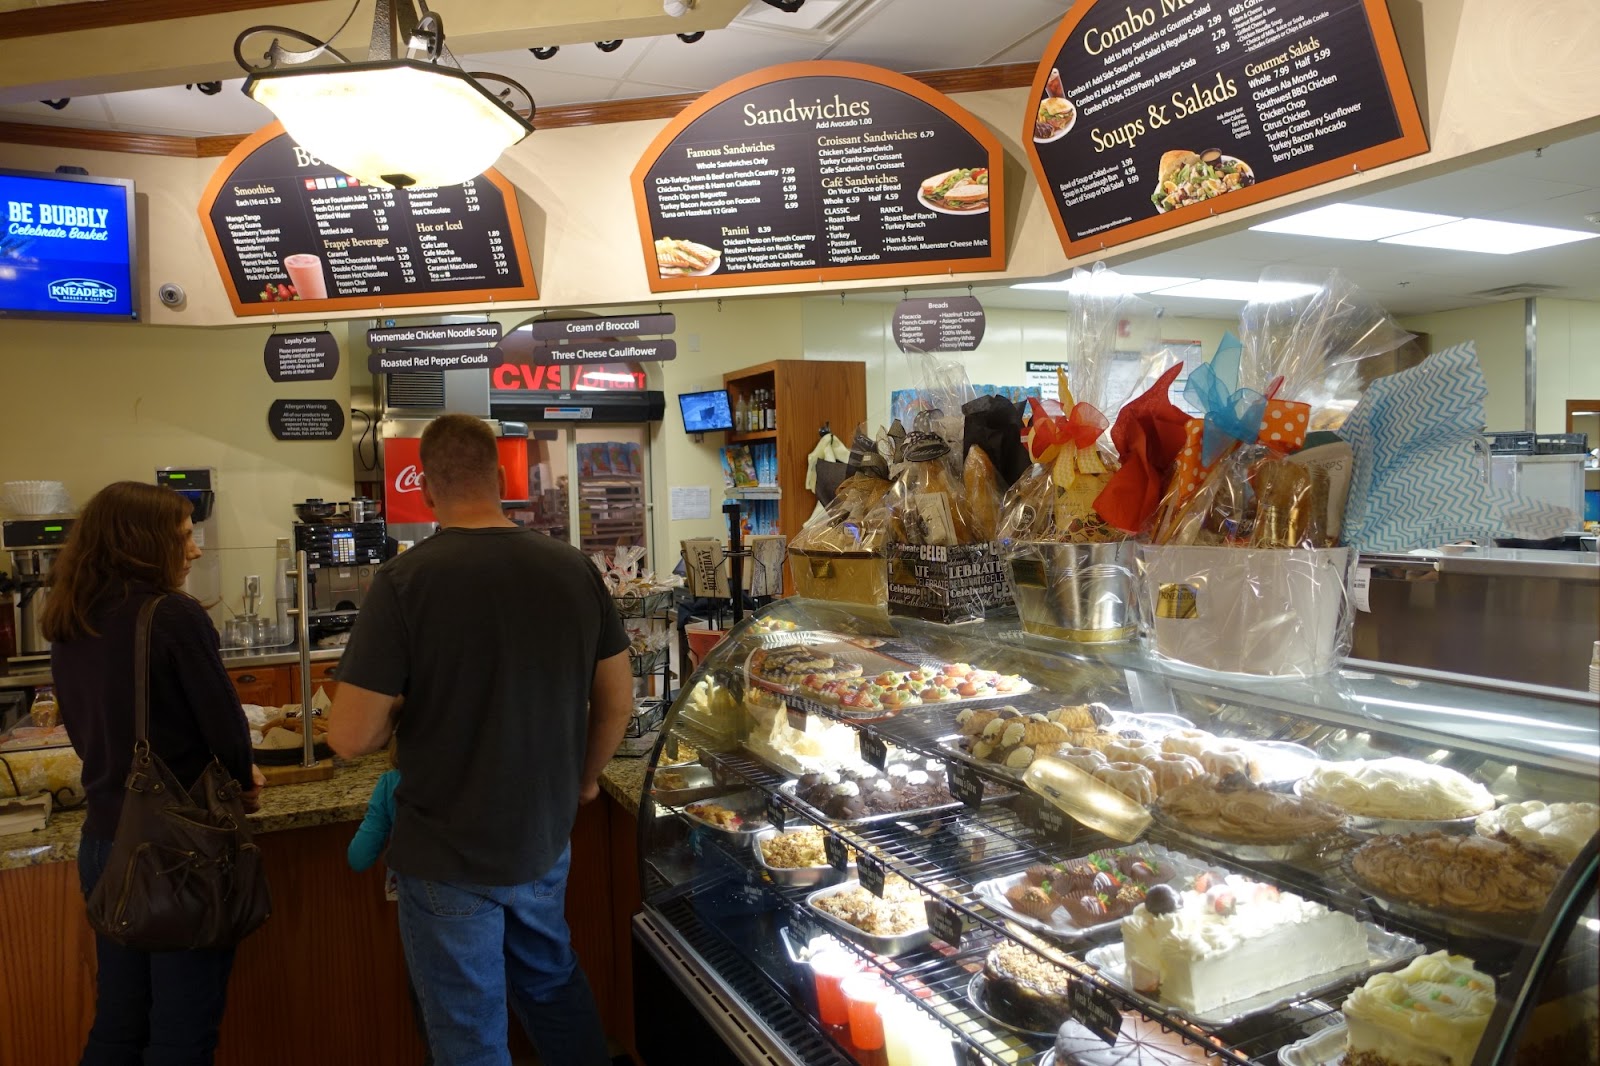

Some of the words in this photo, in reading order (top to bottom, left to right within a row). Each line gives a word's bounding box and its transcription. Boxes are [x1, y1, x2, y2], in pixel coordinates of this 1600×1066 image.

[1084, 6, 1156, 56] Combo
[1103, 55, 1115, 66] Add
[1115, 52, 1122, 60] to
[1122, 46, 1133, 56] Any
[1132, 30, 1160, 51] Sandwich
[1160, 27, 1167, 35] or
[1167, 14, 1193, 32] Gourmet
[1193, 4, 1211, 19] Salad
[1212, 27, 1226, 42] 2.79
[1245, 54, 1288, 77] Gourmet
[1289, 36, 1320, 60] Salads
[1248, 74, 1271, 89] Whole
[1274, 66, 1289, 79] 7.99
[1295, 56, 1310, 70] Half
[1314, 48, 1331, 62] 5.99
[1253, 86, 1280, 101] Chicken
[1280, 79, 1292, 90] Ala
[1292, 70, 1318, 86] Mondo
[1256, 90, 1292, 112] Southwest
[1291, 84, 1308, 100] BBQ
[1308, 74, 1337, 91] Chicken
[744, 94, 870, 126] Sandwiches
[1091, 117, 1145, 152] Soups
[1148, 104, 1171, 129] &
[1172, 72, 1238, 119] Salads
[1260, 106, 1287, 122] Chicken
[1287, 98, 1306, 112] Chop
[1263, 120, 1283, 132] Citrus
[1283, 109, 1310, 124] Chicken
[1266, 127, 1289, 142] Turkey
[1289, 116, 1324, 135] Cranberry
[1324, 103, 1362, 122] Sunflower
[818, 135, 861, 146] Croissant
[864, 129, 918, 143] Sandwiches
[1269, 138, 1292, 153] Turkey
[1292, 130, 1314, 146] Bacon
[1315, 119, 1346, 137] Avocado
[687, 148, 721, 158] Famous
[724, 142, 775, 155] Sandwiches
[819, 148, 844, 157] Chicken
[845, 146, 862, 155] Salad
[863, 144, 893, 153] Sandwich
[1273, 150, 1290, 163] Berry
[1290, 143, 1314, 158] DeLite
[819, 158, 840, 166] Turkey
[841, 155, 872, 164] Cranberry
[821, 177, 843, 188] Café
[845, 173, 898, 186] Sandwiches
[234, 184, 275, 196] Smoothies
[846, 196, 860, 204] 6.59
[868, 193, 881, 202] Half
[8, 201, 33, 223] BE
[39, 204, 108, 228] BUBBLY
[824, 207, 850, 215] CLASSIC
[880, 206, 903, 214] RANCH
[8, 223, 66, 238] Celebrate
[69, 227, 108, 241] Basket
[416, 223, 435, 232] Hot
[445, 220, 463, 230] Iced
[721, 226, 749, 236] Panini
[351, 238, 389, 248] Beverages
[52, 286, 114, 298] KNEADERS
[370, 332, 415, 342] Homemade
[416, 330, 446, 340] Chicken
[447, 328, 475, 338] Noodle
[477, 327, 497, 338] Soup
[567, 324, 593, 333] Cream
[595, 322, 604, 331] of
[606, 320, 640, 330] Broccoli
[381, 358, 413, 368] Roasted
[414, 357, 429, 366] Red
[431, 357, 459, 367] Pepper
[461, 354, 488, 363] Gouda
[552, 351, 575, 360] Three
[577, 349, 607, 358] Cheese
[609, 347, 657, 357] Cauliflower
[492, 364, 561, 390] CVS
